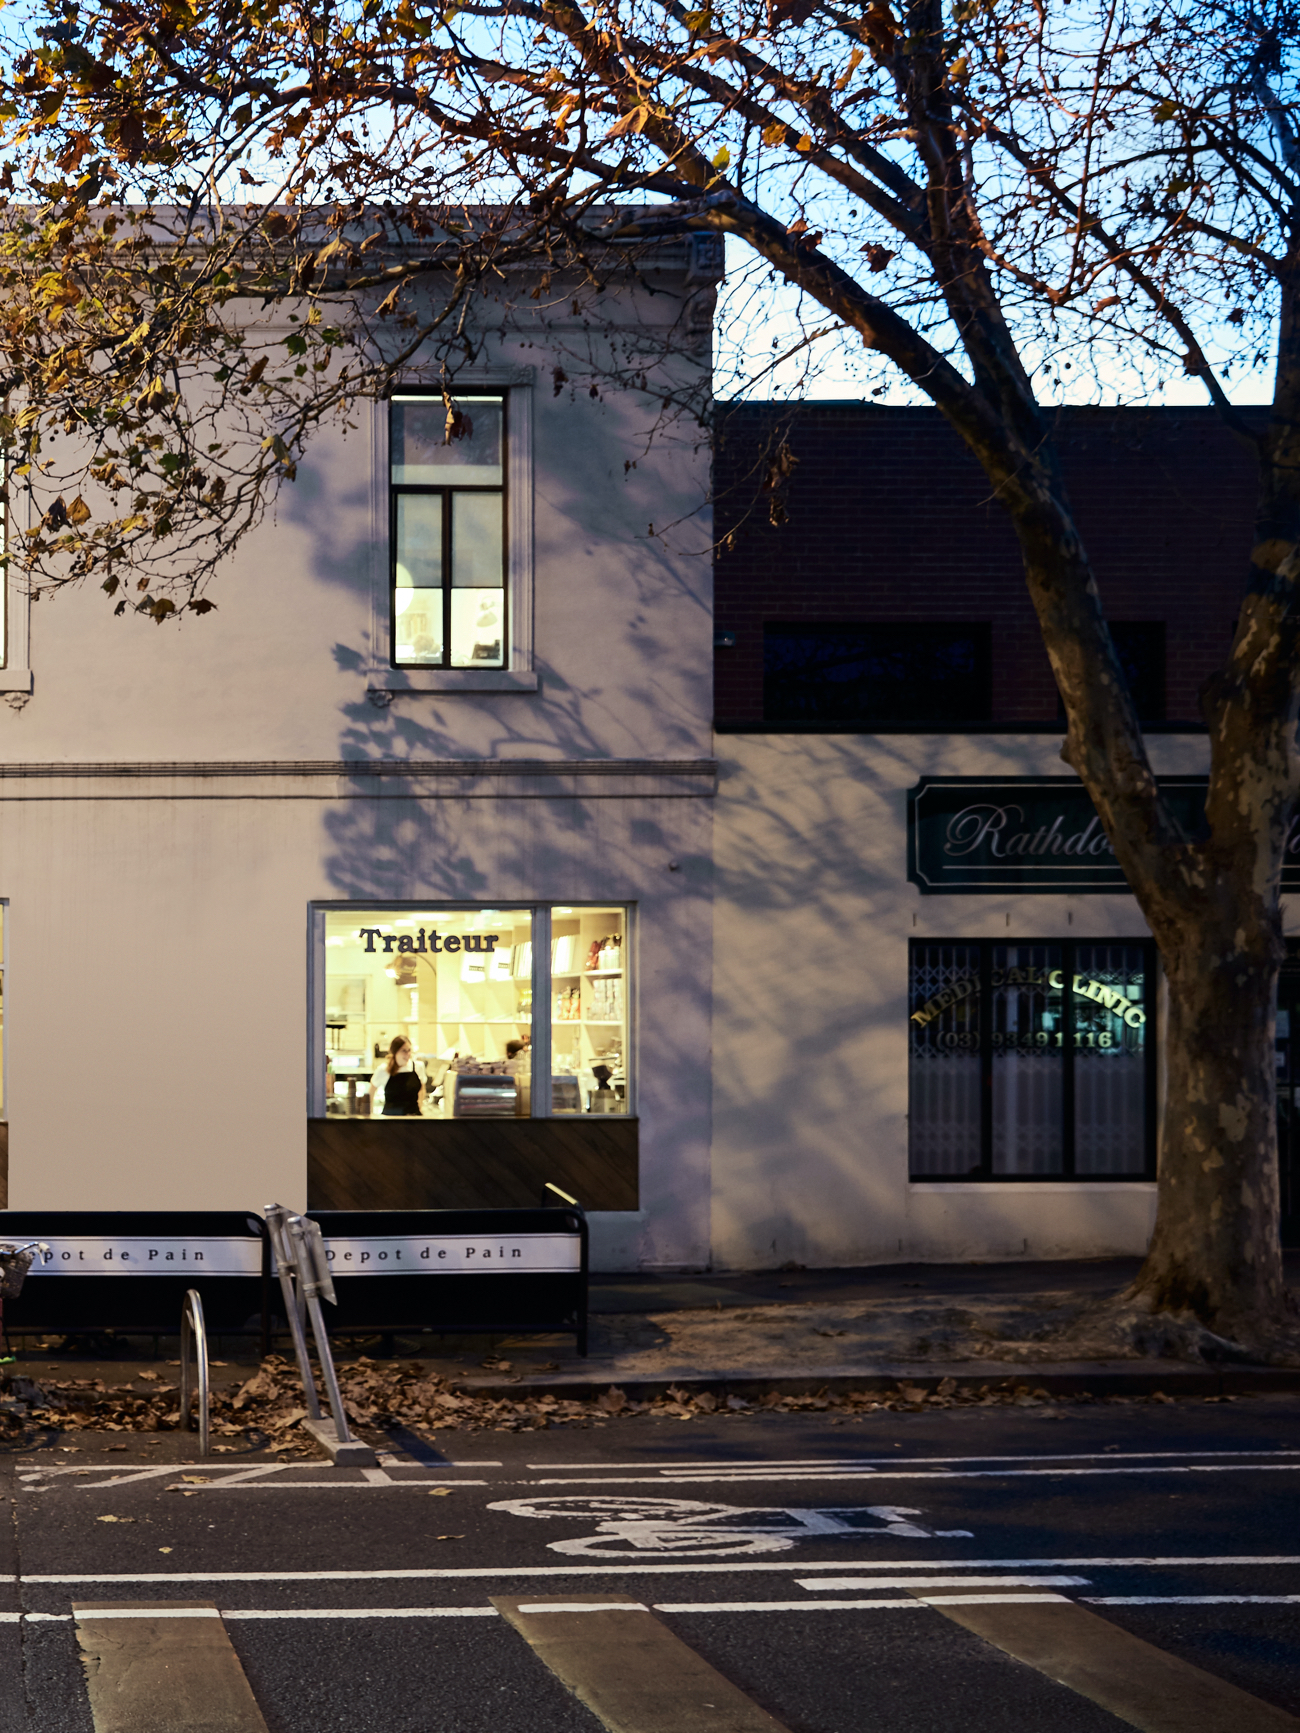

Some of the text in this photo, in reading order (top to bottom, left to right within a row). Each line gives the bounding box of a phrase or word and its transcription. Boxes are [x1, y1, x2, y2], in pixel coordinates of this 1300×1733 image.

[944, 803, 1115, 858] Rathdo
[359, 928, 499, 953] Traiteur
[910, 967, 1147, 1028] MEDICAL CLINIC
[936, 1031, 981, 1050] (03)
[29, 1248, 204, 1264] epot de Pain
[325, 1246, 522, 1264] Depot de Pain
